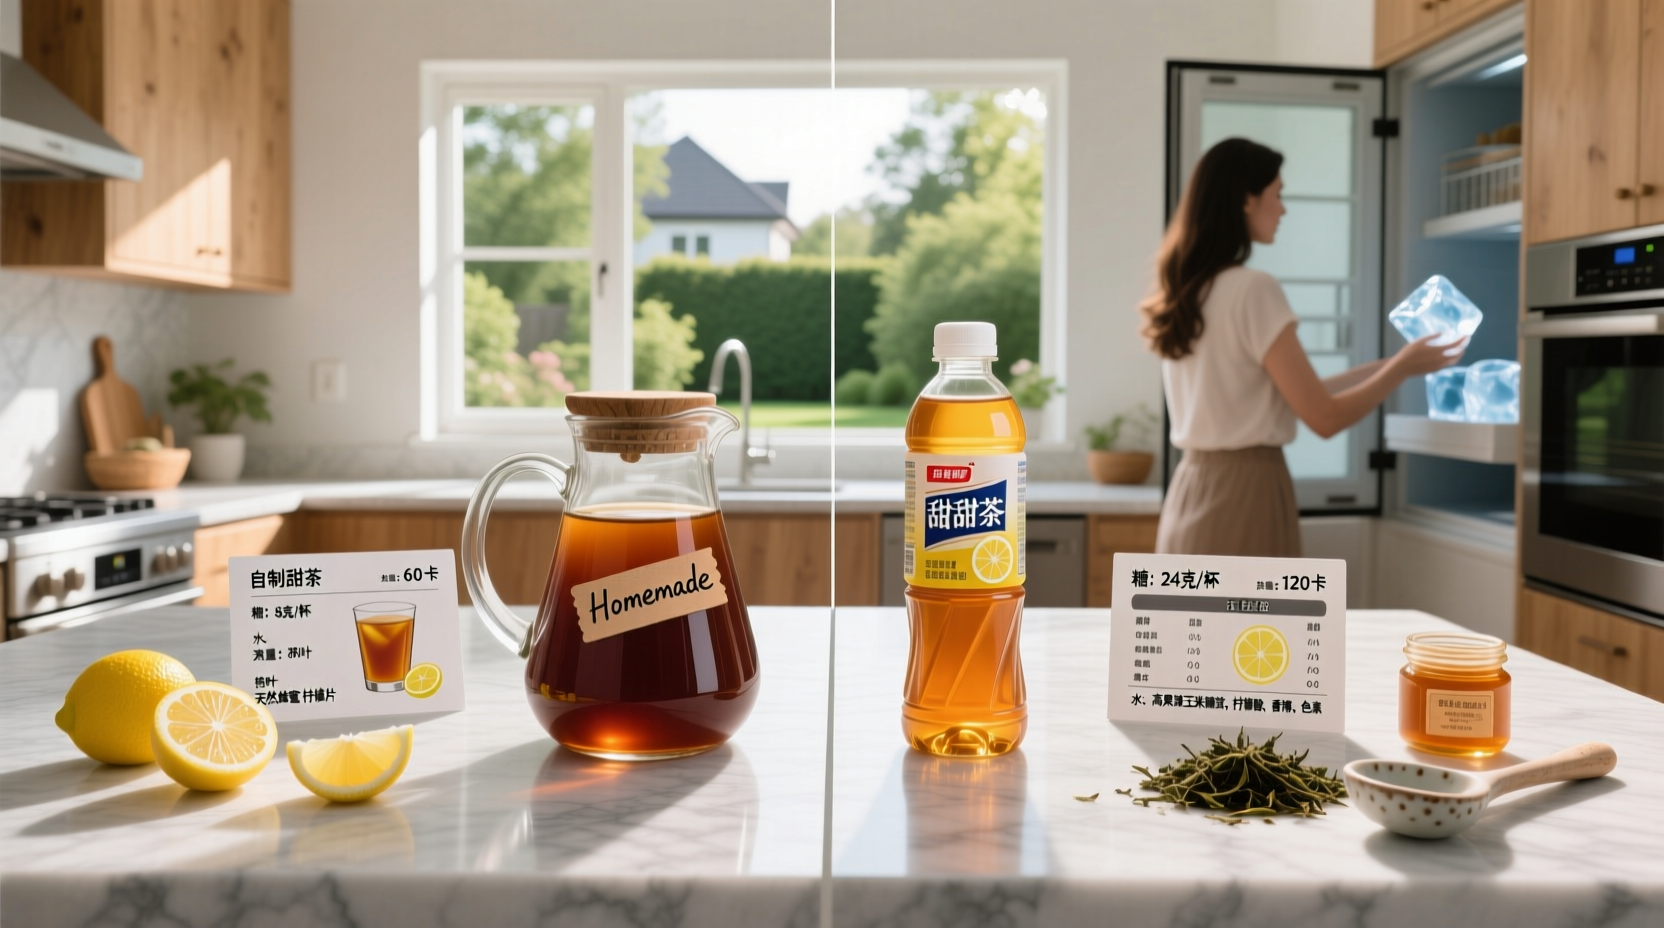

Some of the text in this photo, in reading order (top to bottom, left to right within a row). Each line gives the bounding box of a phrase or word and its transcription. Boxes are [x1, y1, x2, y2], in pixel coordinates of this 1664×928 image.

[927, 497, 1005, 530] 甜甜茶
[590, 562, 714, 624] Homemade
